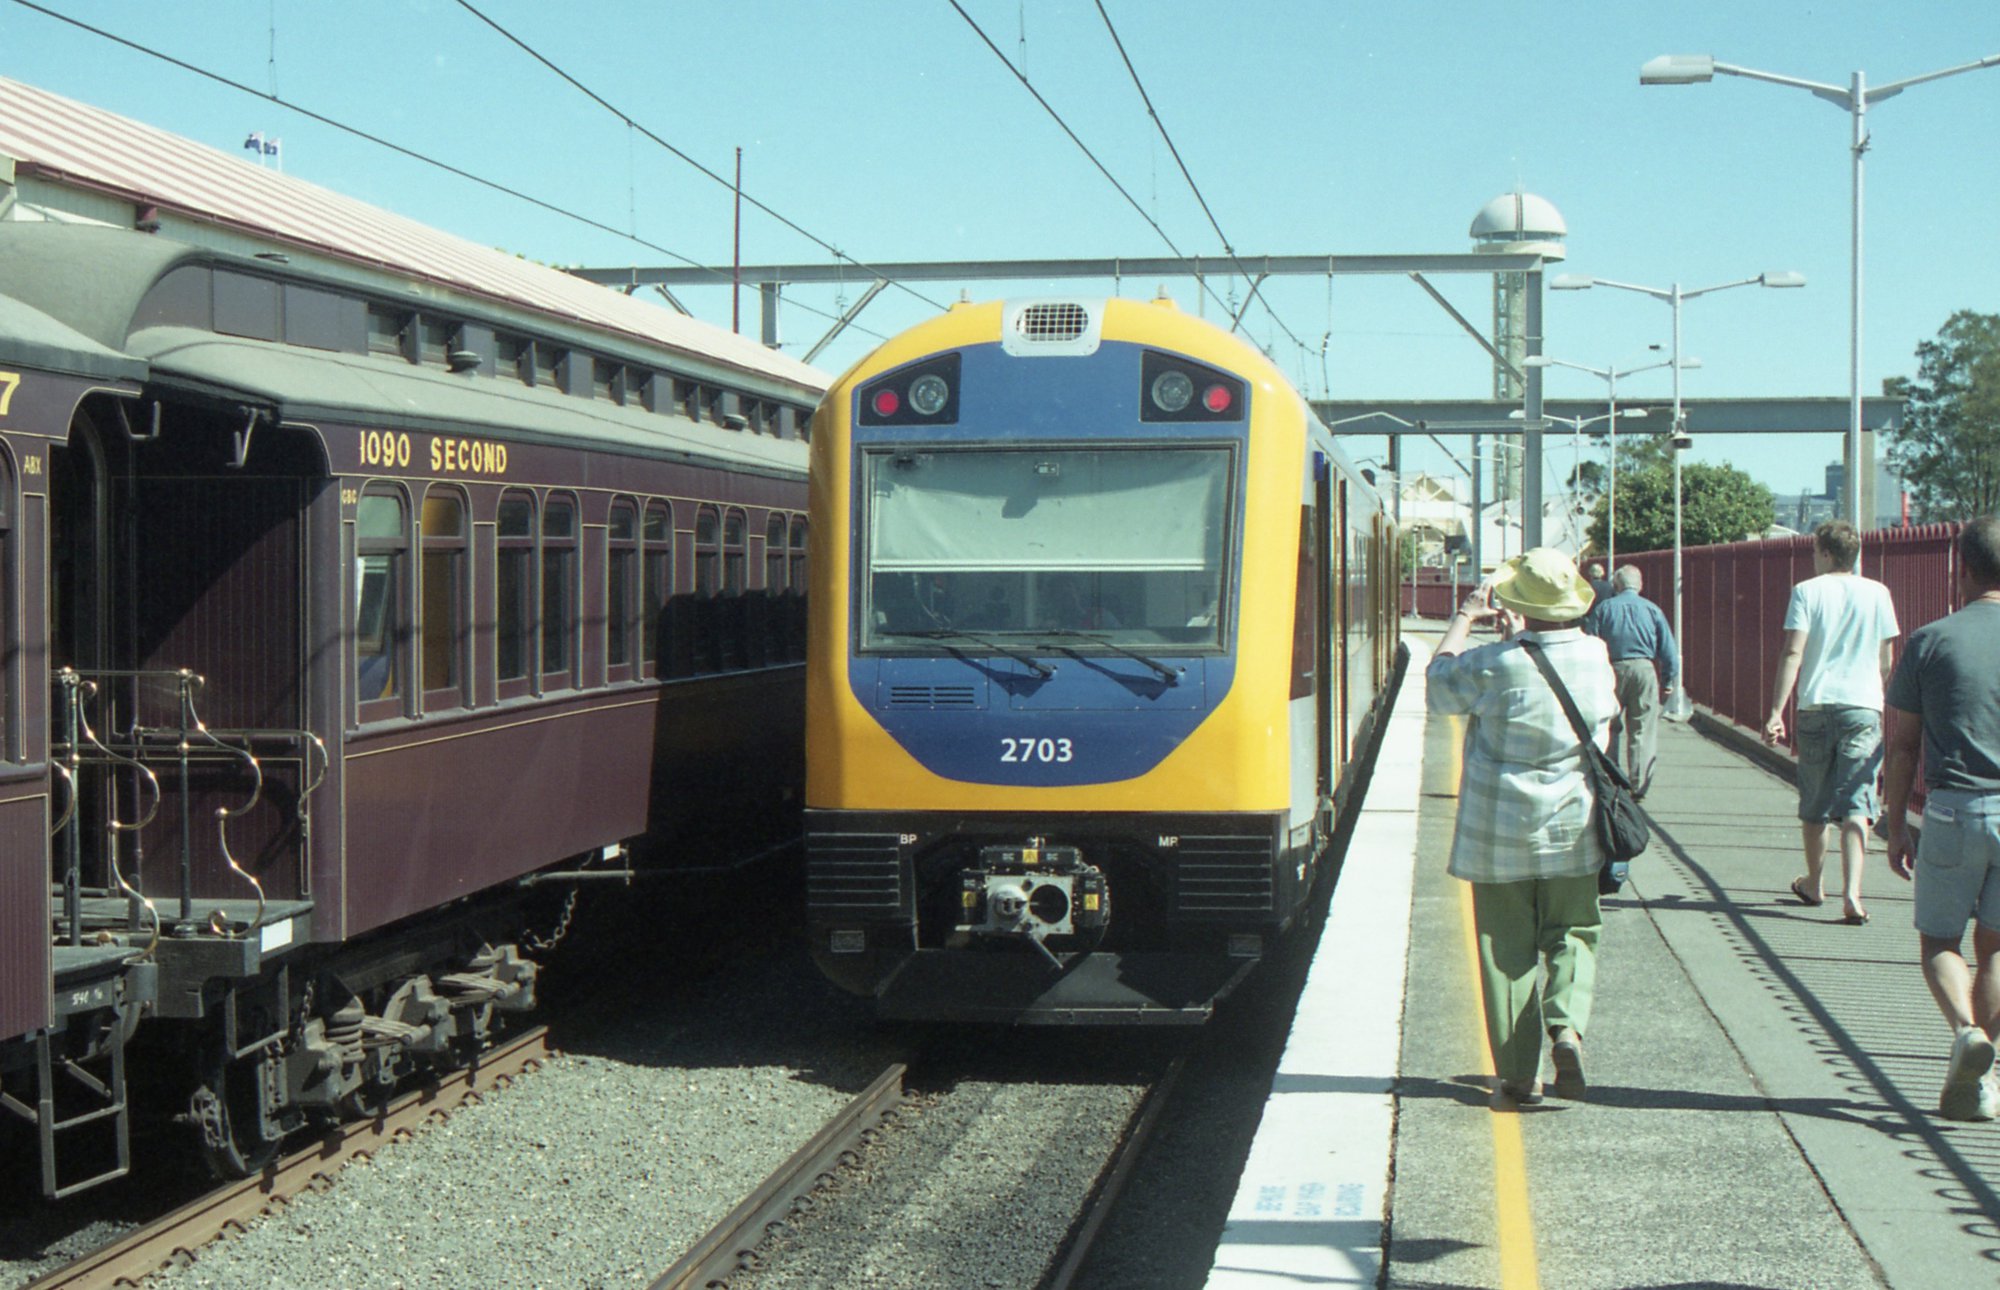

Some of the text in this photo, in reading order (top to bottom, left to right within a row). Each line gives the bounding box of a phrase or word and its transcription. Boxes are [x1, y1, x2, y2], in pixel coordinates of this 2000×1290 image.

[360, 430, 507, 473] 1090 SECOND
[24, 455, 42, 474] ABX
[1000, 737, 1073, 762] 2703
[900, 834, 917, 844] BP
